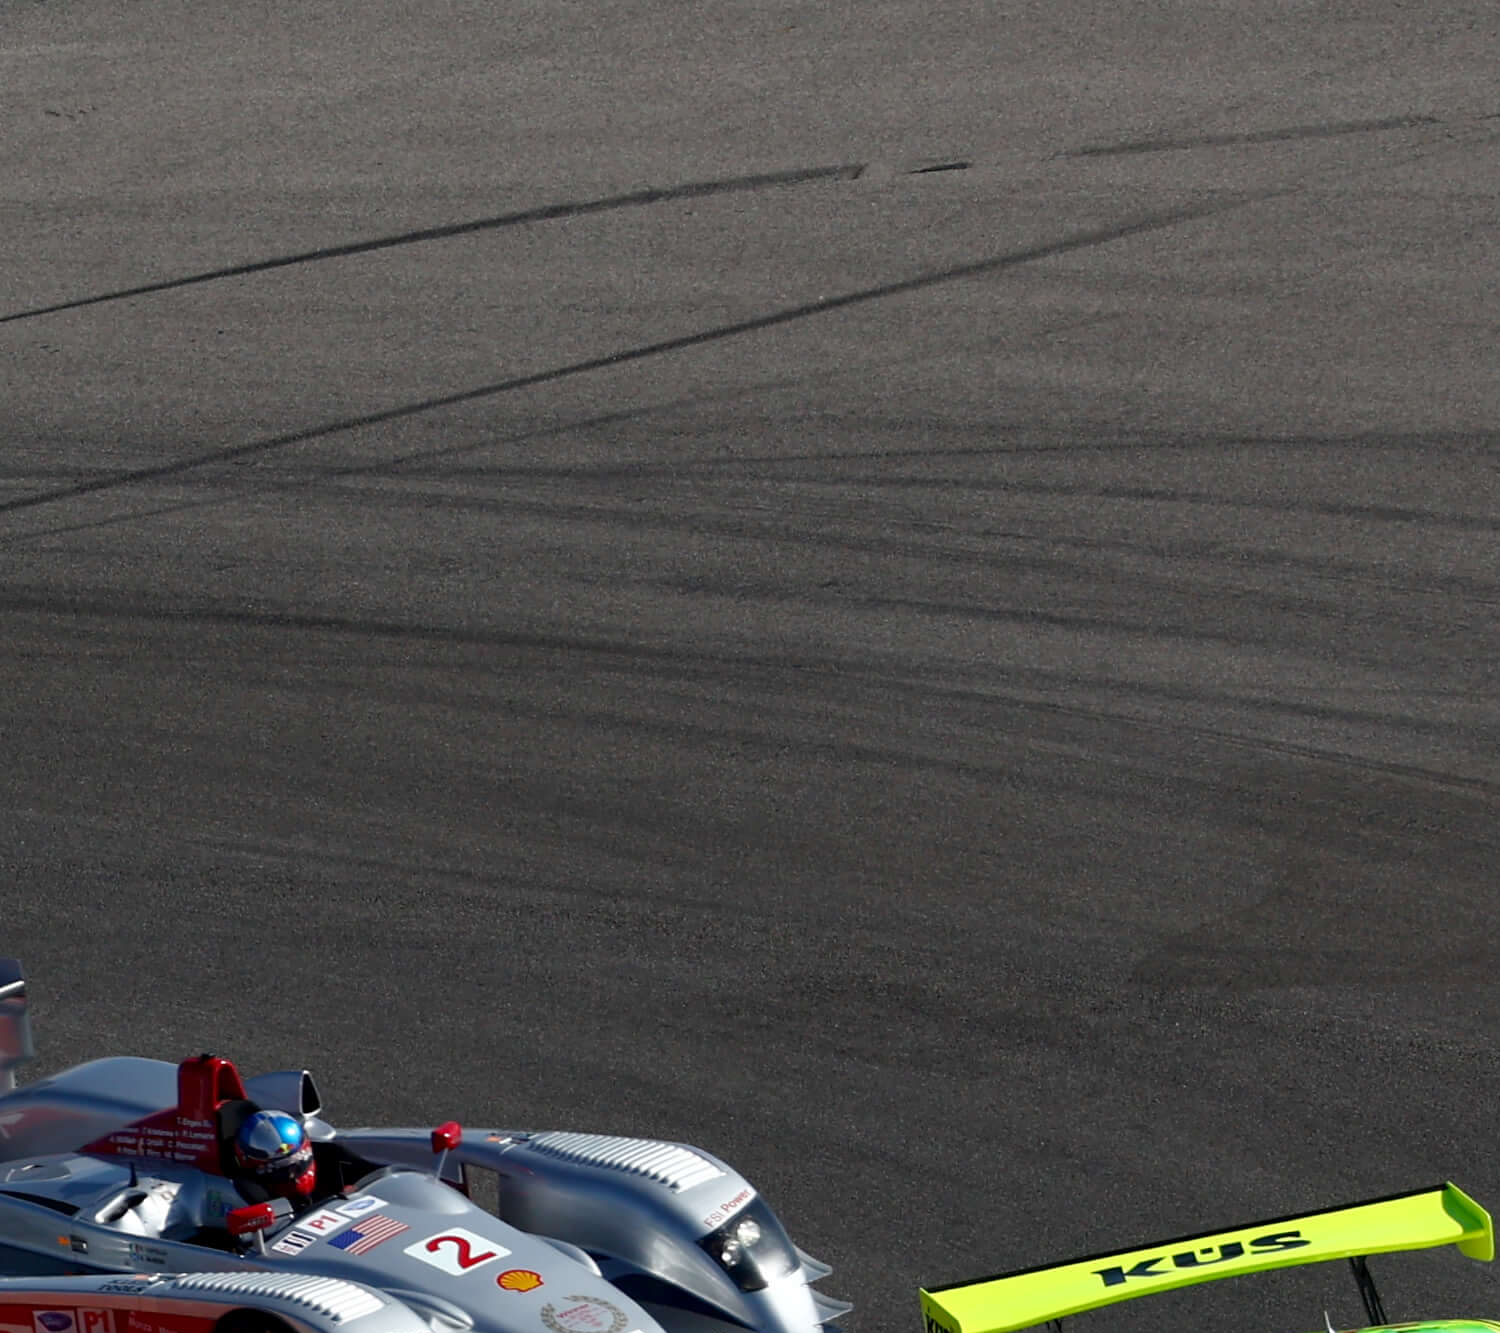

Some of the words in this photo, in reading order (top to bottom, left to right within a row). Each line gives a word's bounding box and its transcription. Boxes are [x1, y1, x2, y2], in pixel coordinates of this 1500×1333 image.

[720, 1188, 751, 1213] Power
[308, 1214, 339, 1230] P1
[425, 1235, 497, 1269] 2
[1091, 1230, 1312, 1288] KÜS
